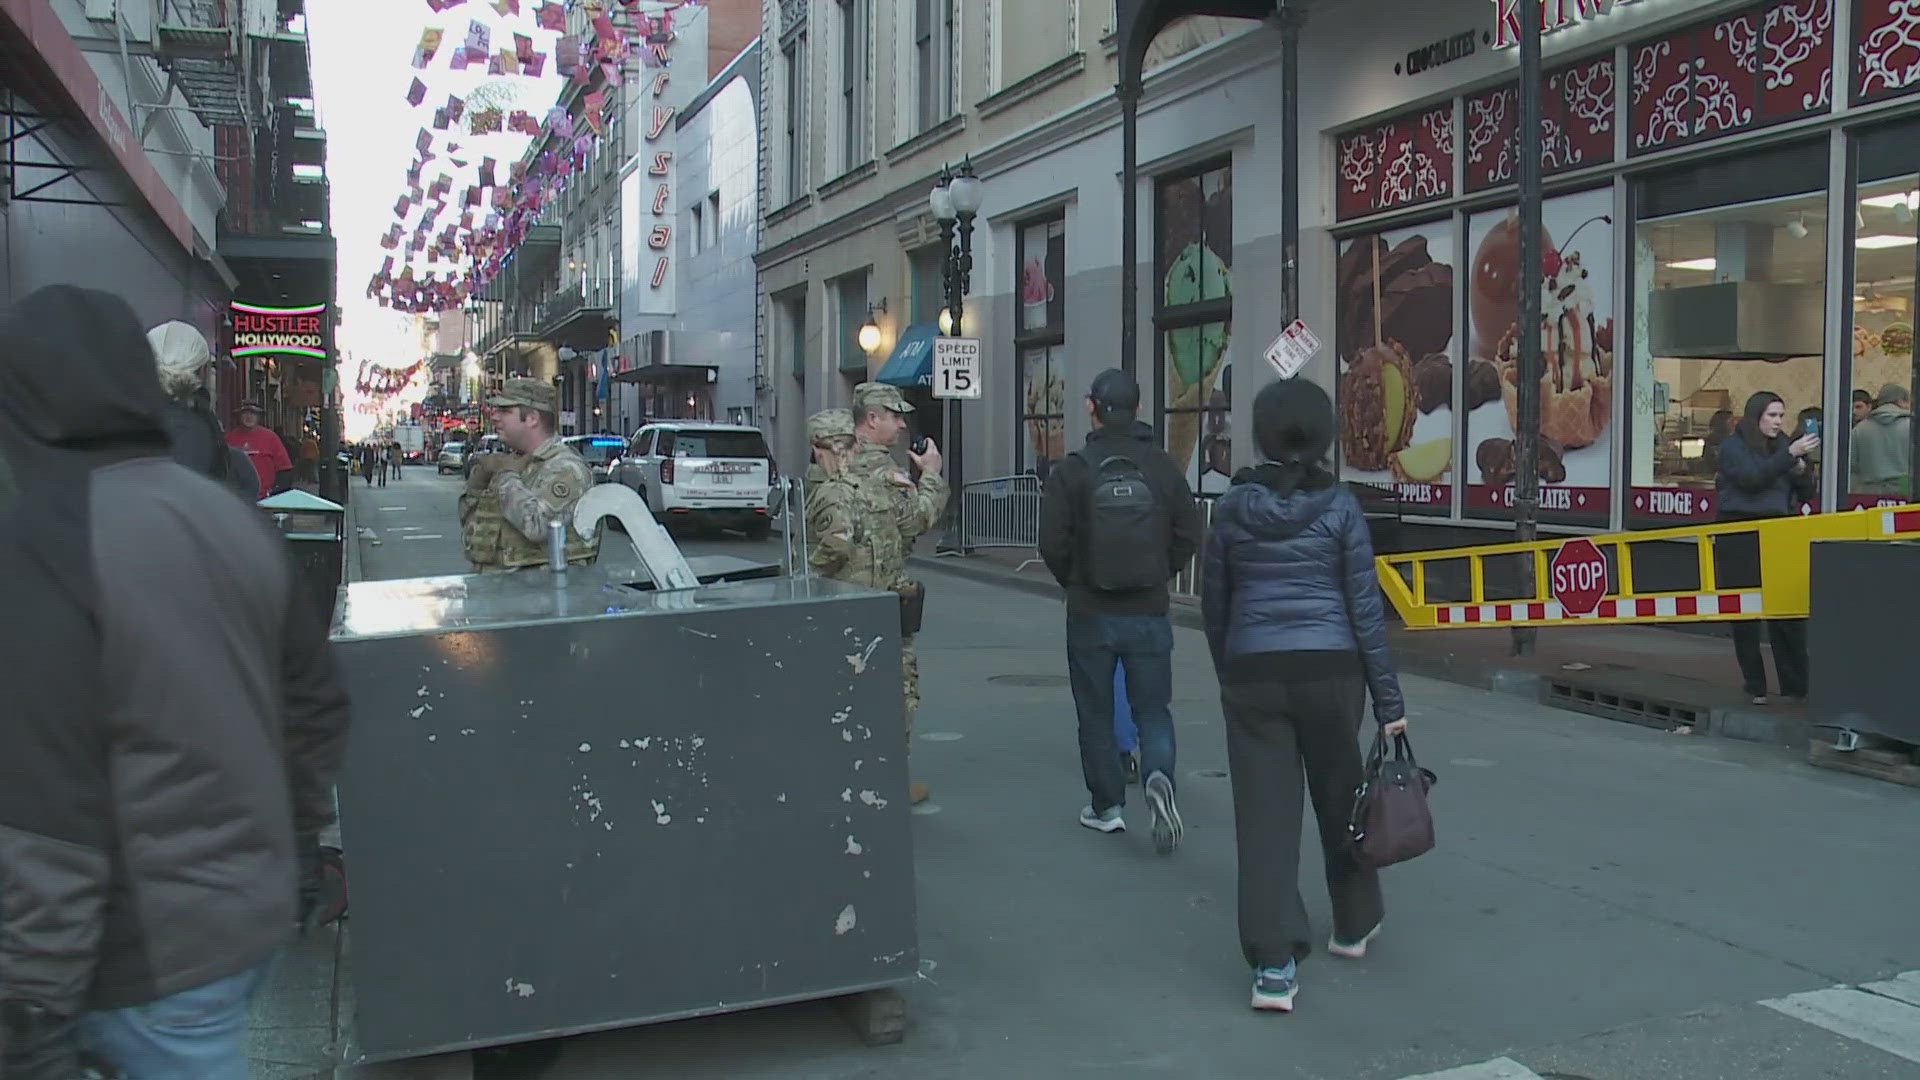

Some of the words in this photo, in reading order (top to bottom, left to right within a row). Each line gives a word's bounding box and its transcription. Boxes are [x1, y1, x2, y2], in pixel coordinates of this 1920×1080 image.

[234, 315, 320, 333] HUSTLER
[234, 333, 322, 347] HOLLYWOOD
[937, 344, 977, 355] SPEED
[941, 357, 972, 367] LIMIT
[917, 374, 933, 386] AT
[942, 368, 971, 391] 15
[1398, 482, 1432, 502] APPLES
[1504, 487, 1571, 510] CHLATES
[1649, 490, 1692, 515] FUDGE
[1555, 561, 1603, 593] STOP
